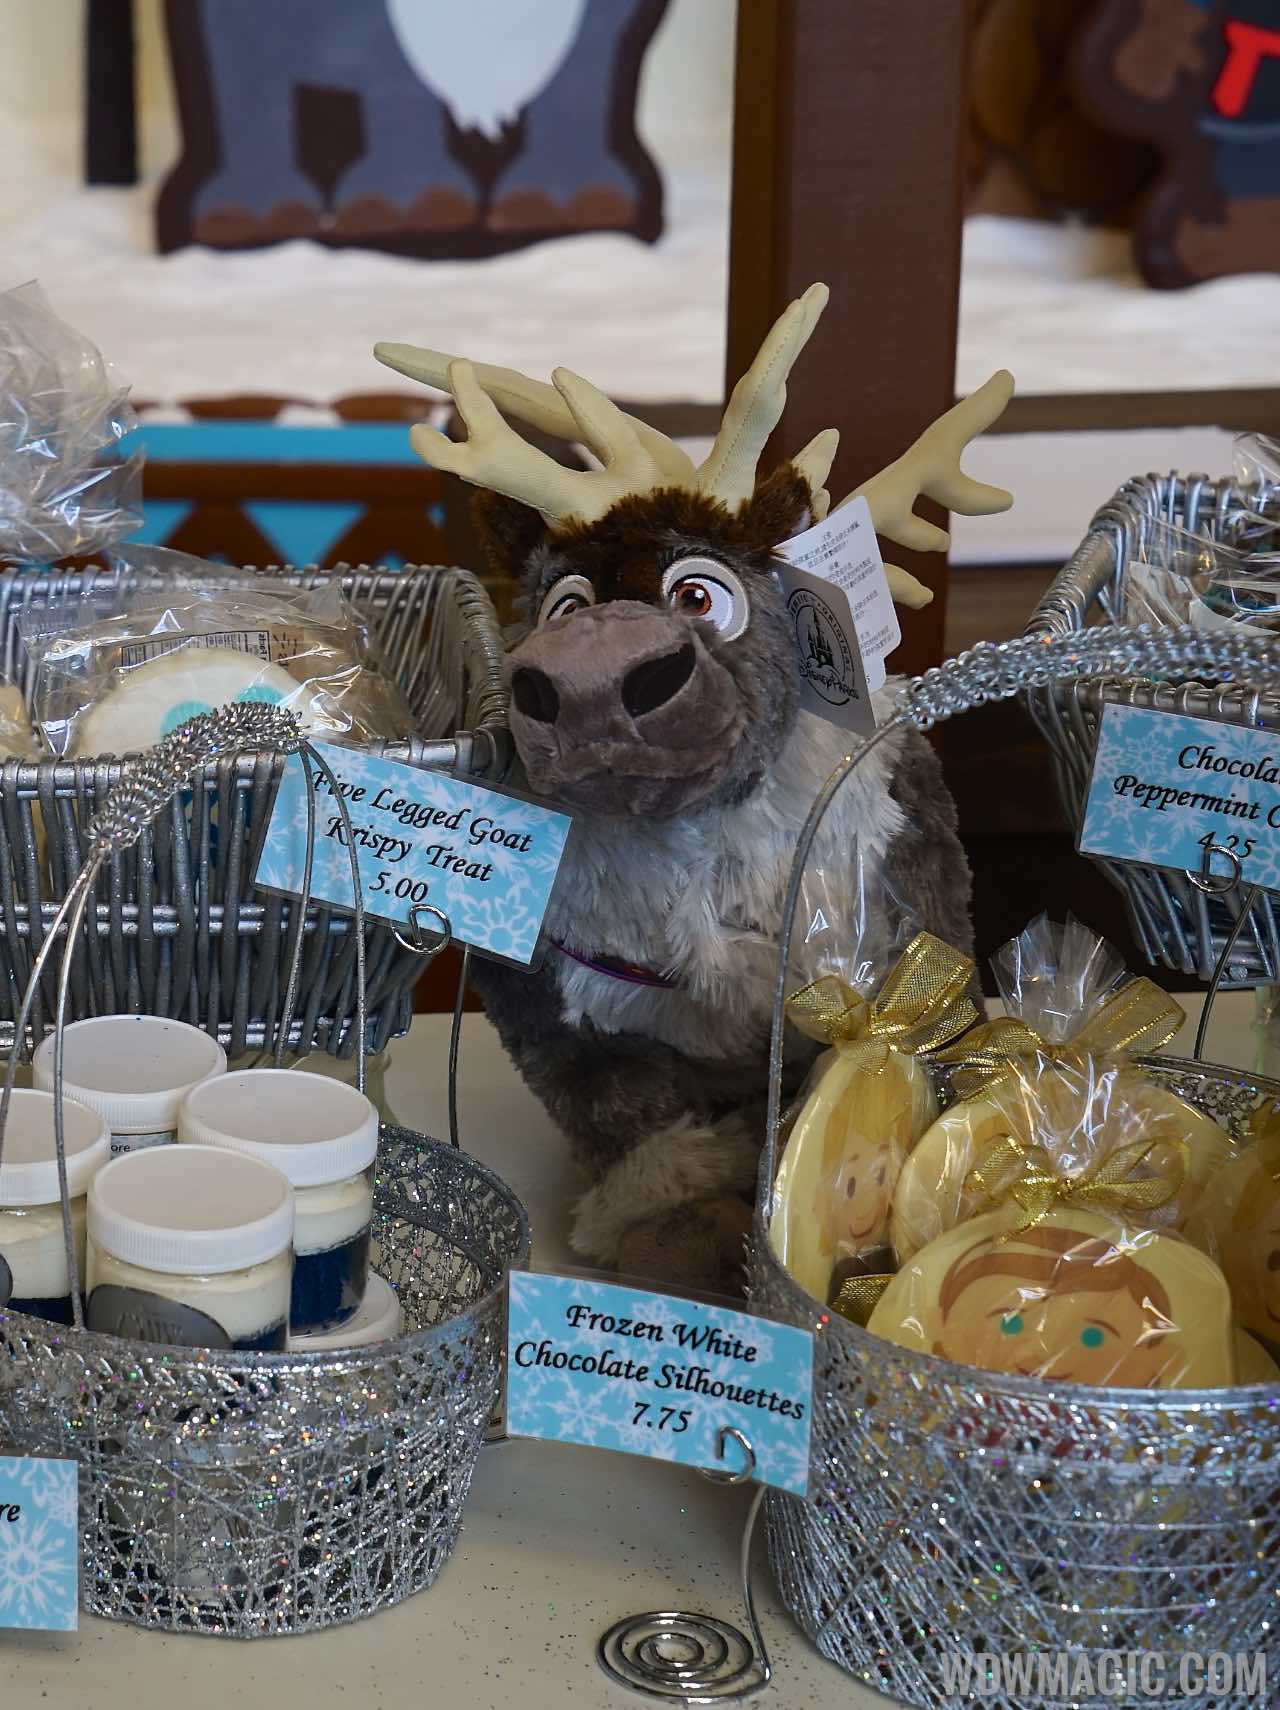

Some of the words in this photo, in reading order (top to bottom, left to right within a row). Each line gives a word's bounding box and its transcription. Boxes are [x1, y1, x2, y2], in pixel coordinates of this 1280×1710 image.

[1178, 746, 1280, 785] Chocola
[369, 787, 472, 830] Legged
[468, 817, 534, 853] Goat
[1113, 775, 1262, 820] Peppermint
[325, 816, 413, 862] Krispy
[426, 844, 494, 882] Treat
[1197, 831, 1258, 858] 425
[369, 871, 431, 903] 5.00
[566, 1304, 665, 1342] Frozen
[672, 1323, 757, 1362] White
[514, 1340, 649, 1383] Chocolate
[654, 1364, 806, 1420] Silhouettes
[631, 1401, 693, 1433] 7.75
